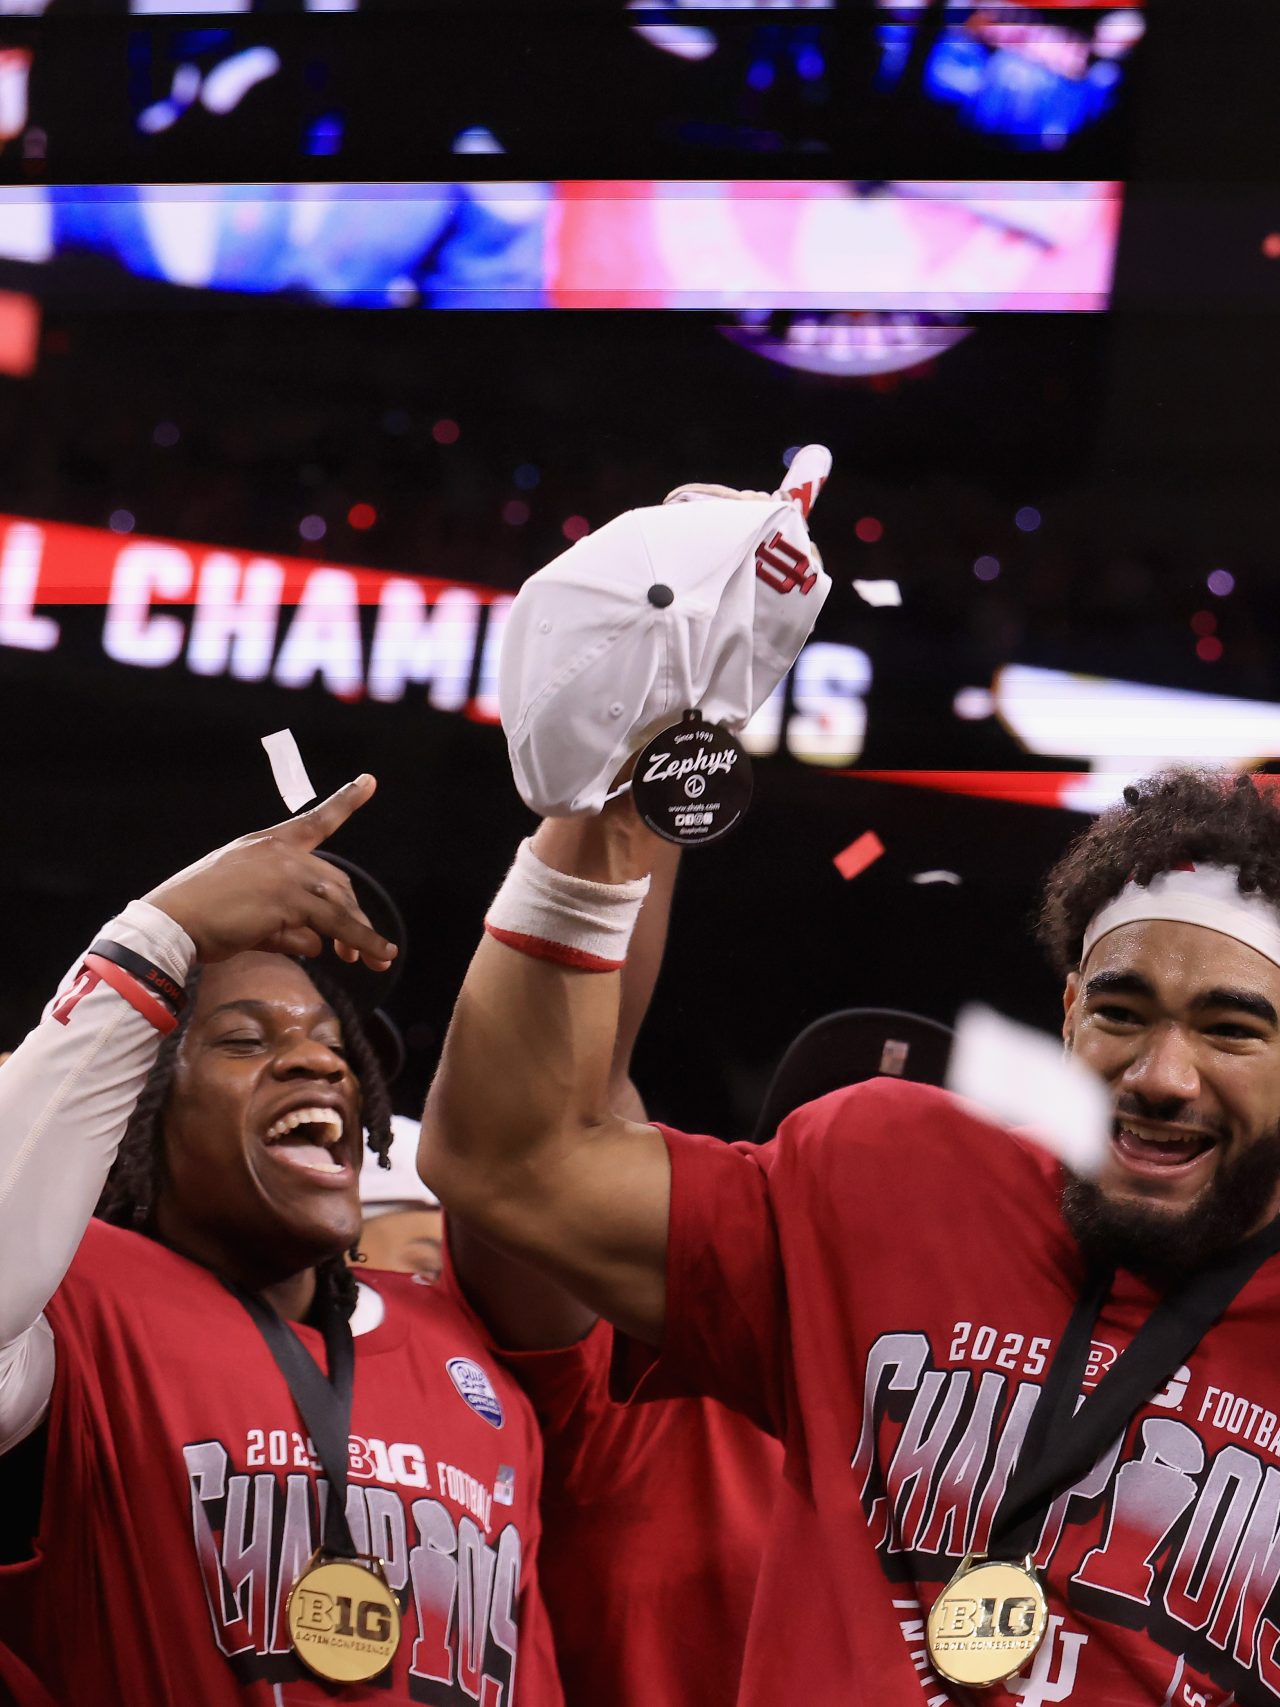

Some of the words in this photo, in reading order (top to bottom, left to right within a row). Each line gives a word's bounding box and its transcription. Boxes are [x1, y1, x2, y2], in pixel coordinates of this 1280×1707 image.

[674, 733, 694, 744] Since
[642, 747, 738, 782] Zephyr
[949, 1321, 1052, 1376] 2025
